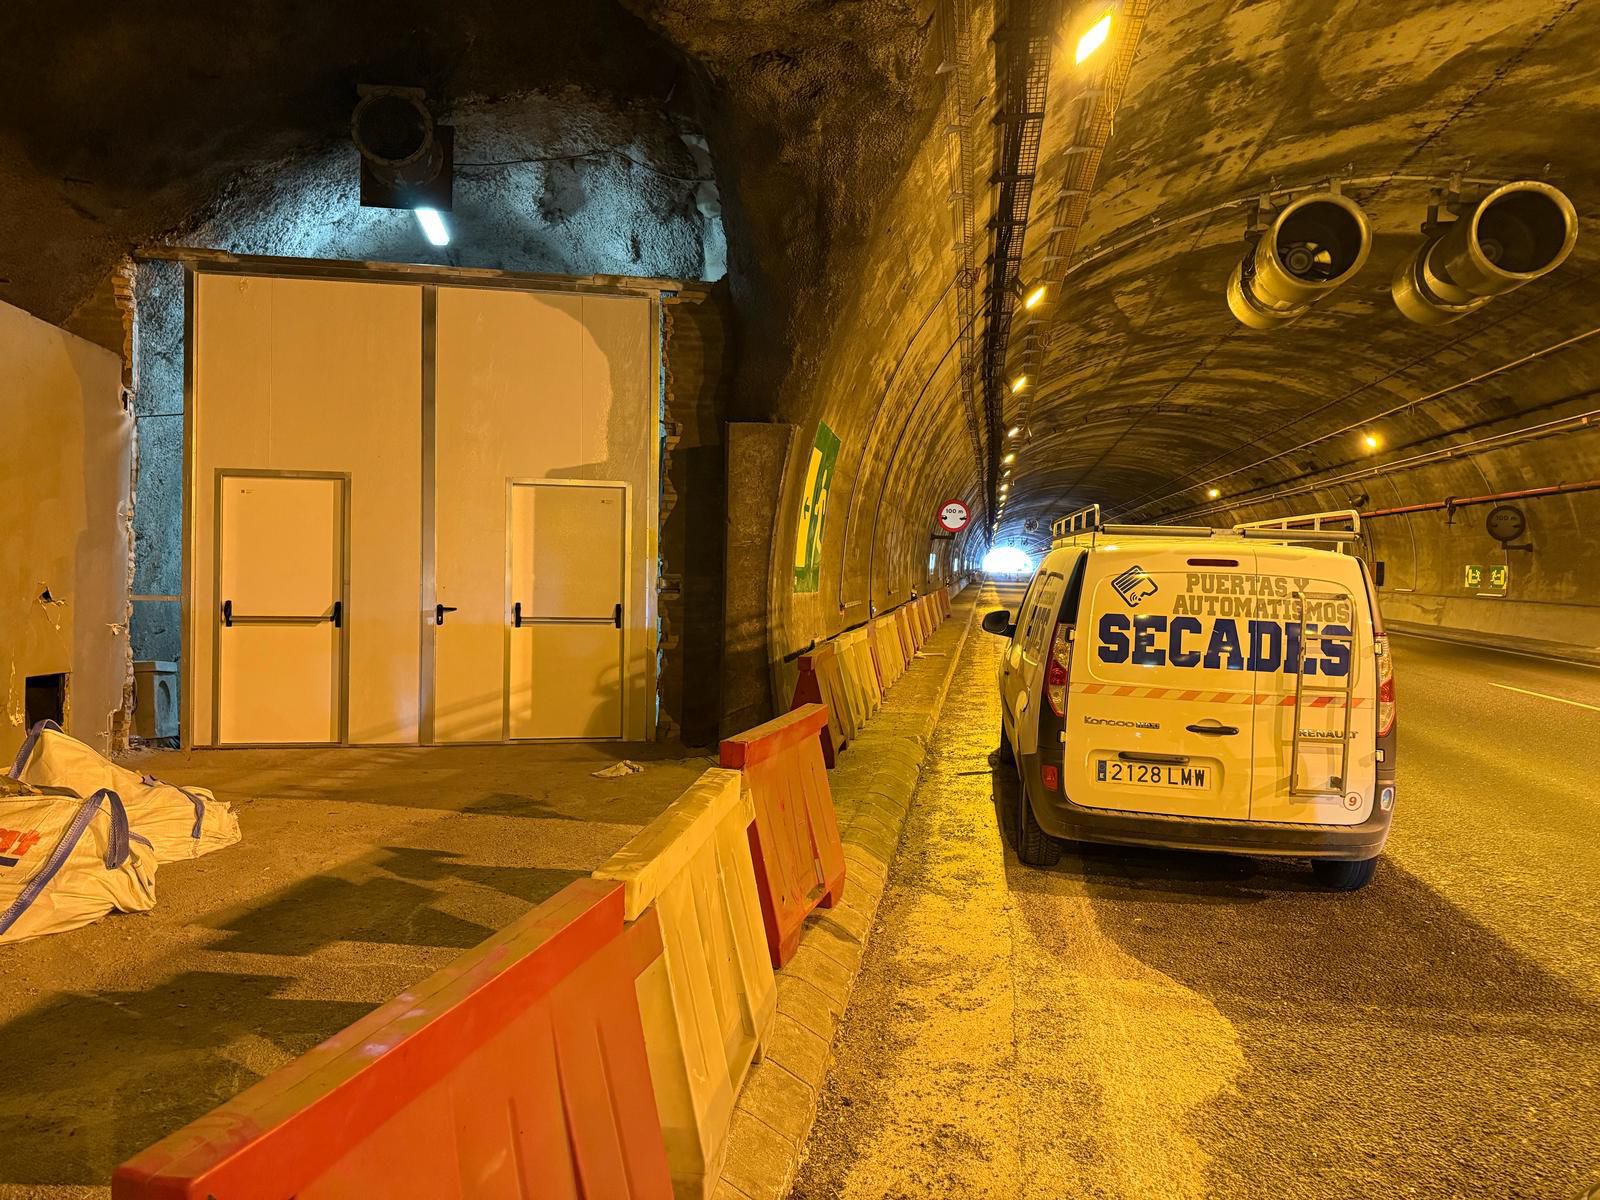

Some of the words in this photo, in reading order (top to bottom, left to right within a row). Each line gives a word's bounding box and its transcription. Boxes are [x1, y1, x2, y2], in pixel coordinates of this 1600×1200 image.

[1185, 573, 1288, 597] PUERTAS
[1294, 577, 1310, 594] Y
[1172, 594, 1350, 624] AUTOMATISMOS
[1097, 613, 1353, 677] SECADES
[1298, 728, 1359, 739] RENAUT
[1111, 763, 1162, 784] 2128
[1167, 767, 1205, 787] LMW
[1348, 796, 1358, 807] 9
